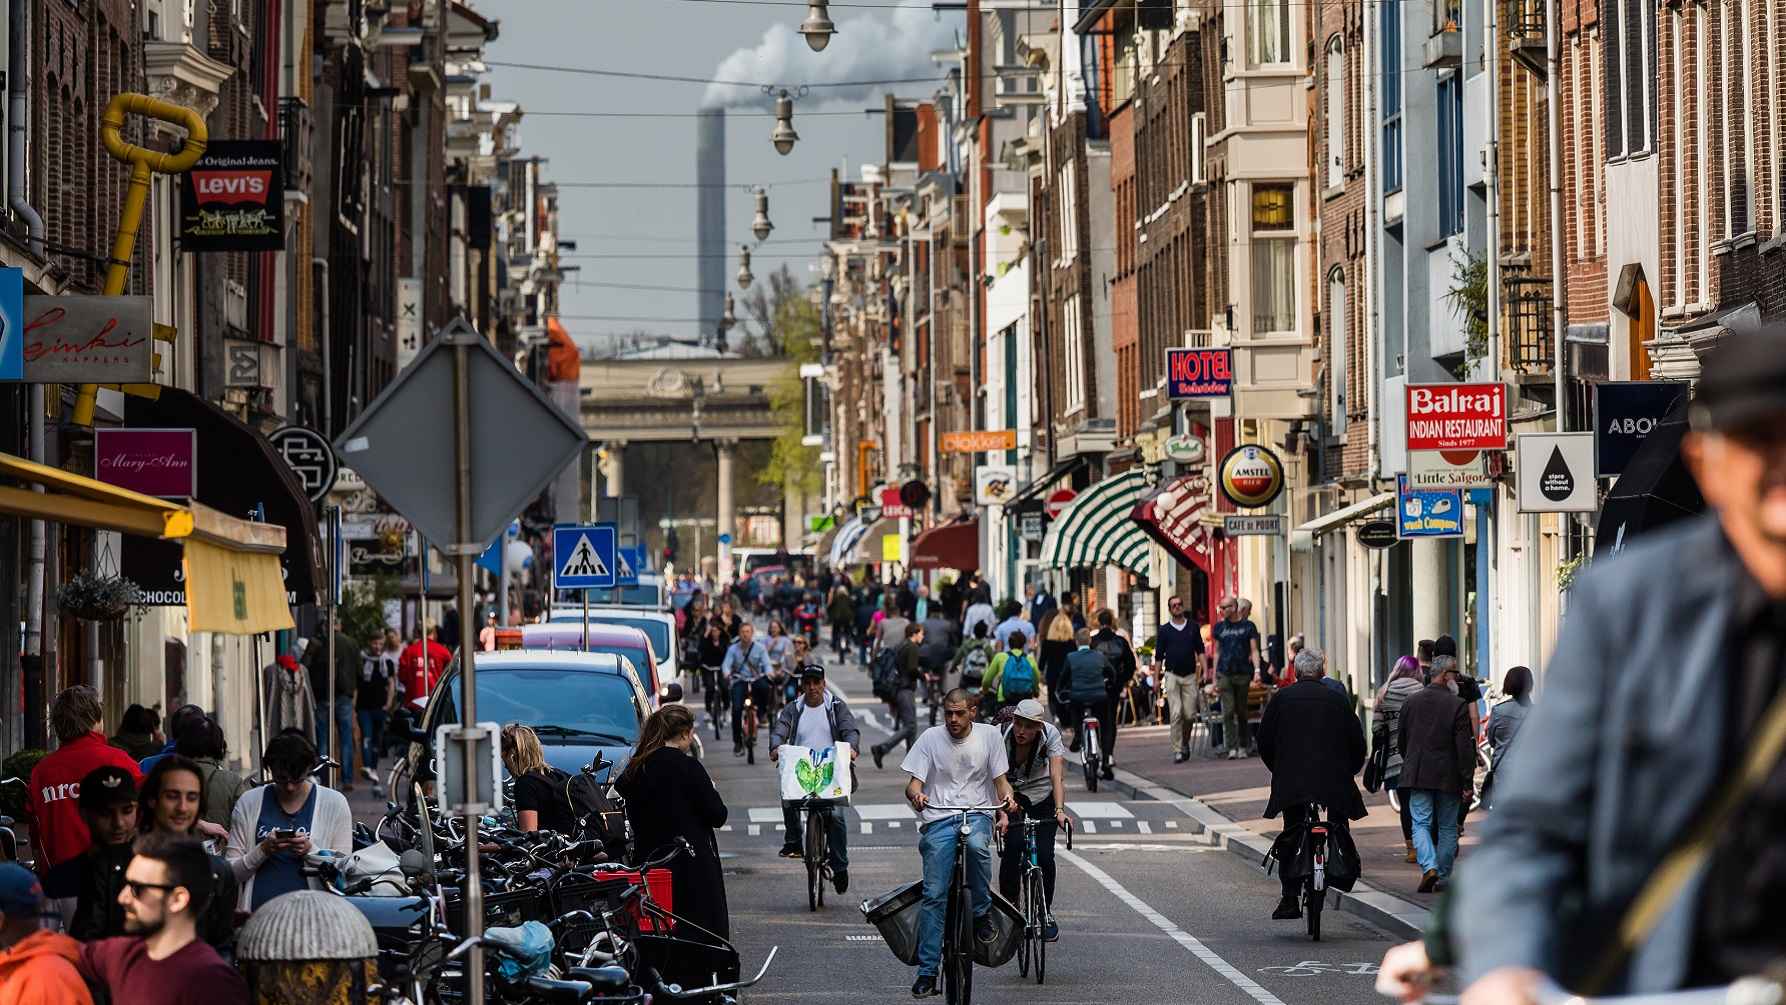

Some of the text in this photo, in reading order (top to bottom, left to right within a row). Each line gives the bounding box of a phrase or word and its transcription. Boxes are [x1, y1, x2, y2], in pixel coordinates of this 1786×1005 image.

[1171, 352, 1232, 381] HOTEL
[1410, 387, 1501, 417] Balraj
[1409, 418, 1503, 439] INDIAN RESTAURANT
[1608, 417, 1657, 434] ABO
[100, 453, 188, 473] Mary-Ann
[1235, 468, 1270, 477] AMSTEL
[138, 591, 187, 604] CHOCOL
[42, 783, 81, 804] nrc
